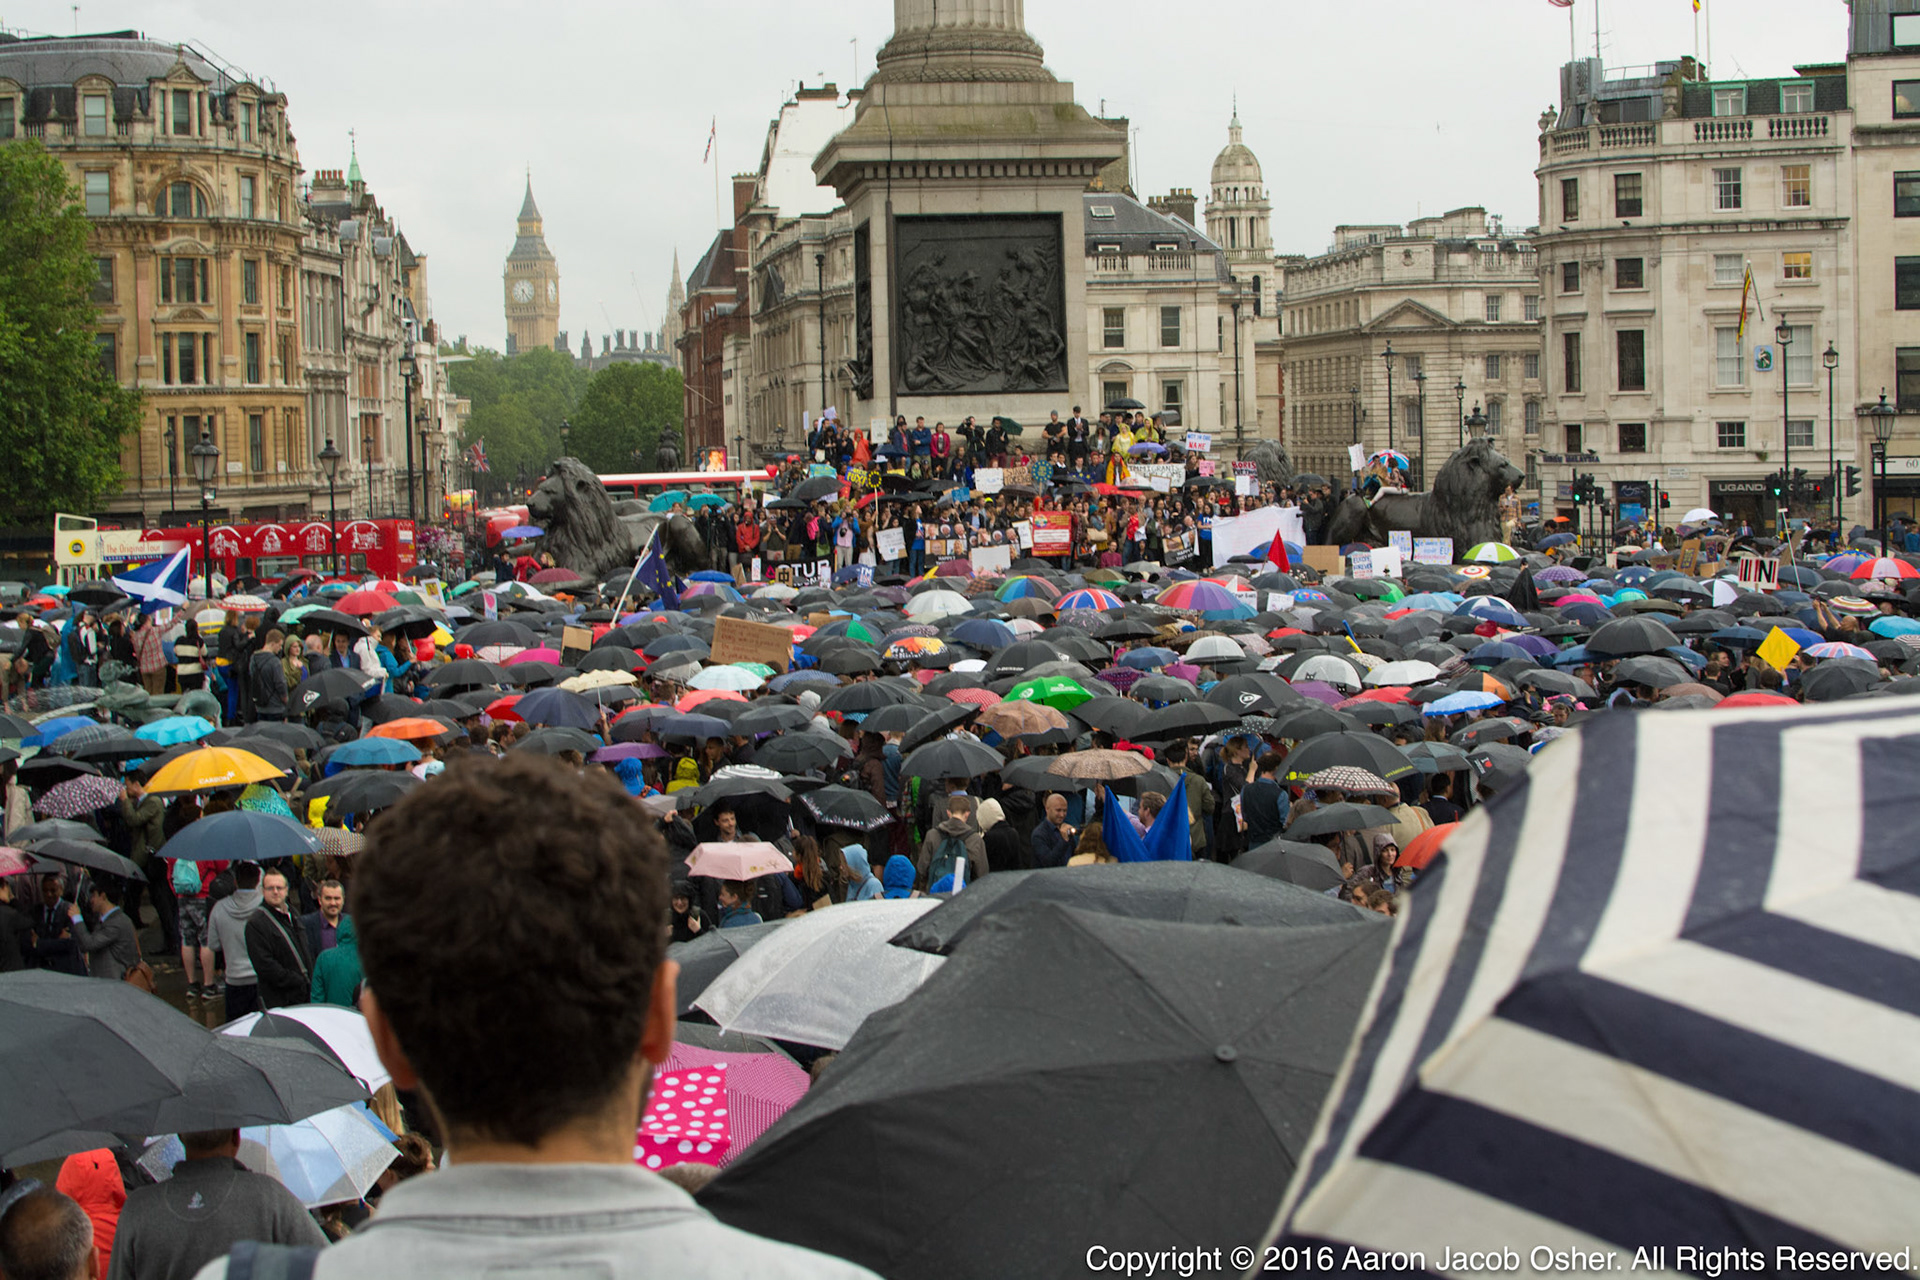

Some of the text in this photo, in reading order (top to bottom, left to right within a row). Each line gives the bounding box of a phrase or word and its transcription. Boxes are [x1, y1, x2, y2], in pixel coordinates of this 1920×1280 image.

[1189, 442, 1206, 450] NAME
[1231, 460, 1257, 469] BORIS
[1906, 459, 1919, 468] 60
